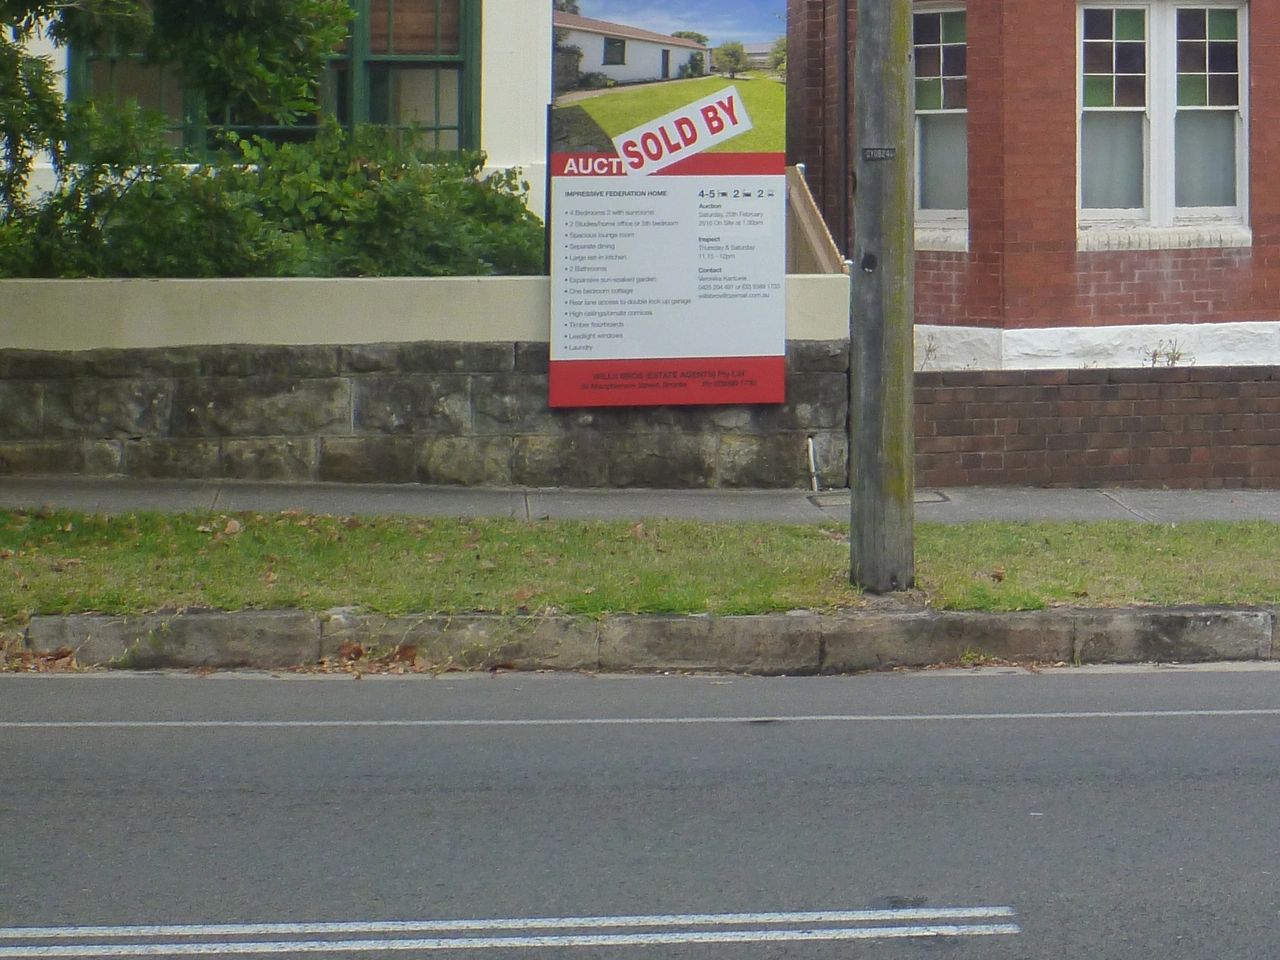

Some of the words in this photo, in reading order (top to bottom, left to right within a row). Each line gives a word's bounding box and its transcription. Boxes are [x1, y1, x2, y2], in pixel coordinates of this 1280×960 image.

[622, 116, 698, 170] SOLD
[700, 96, 738, 135] BY
[563, 158, 658, 173] AUCTI
[698, 190, 715, 198] 4-5
[733, 190, 740, 198] 2
[757, 190, 764, 198] 2
